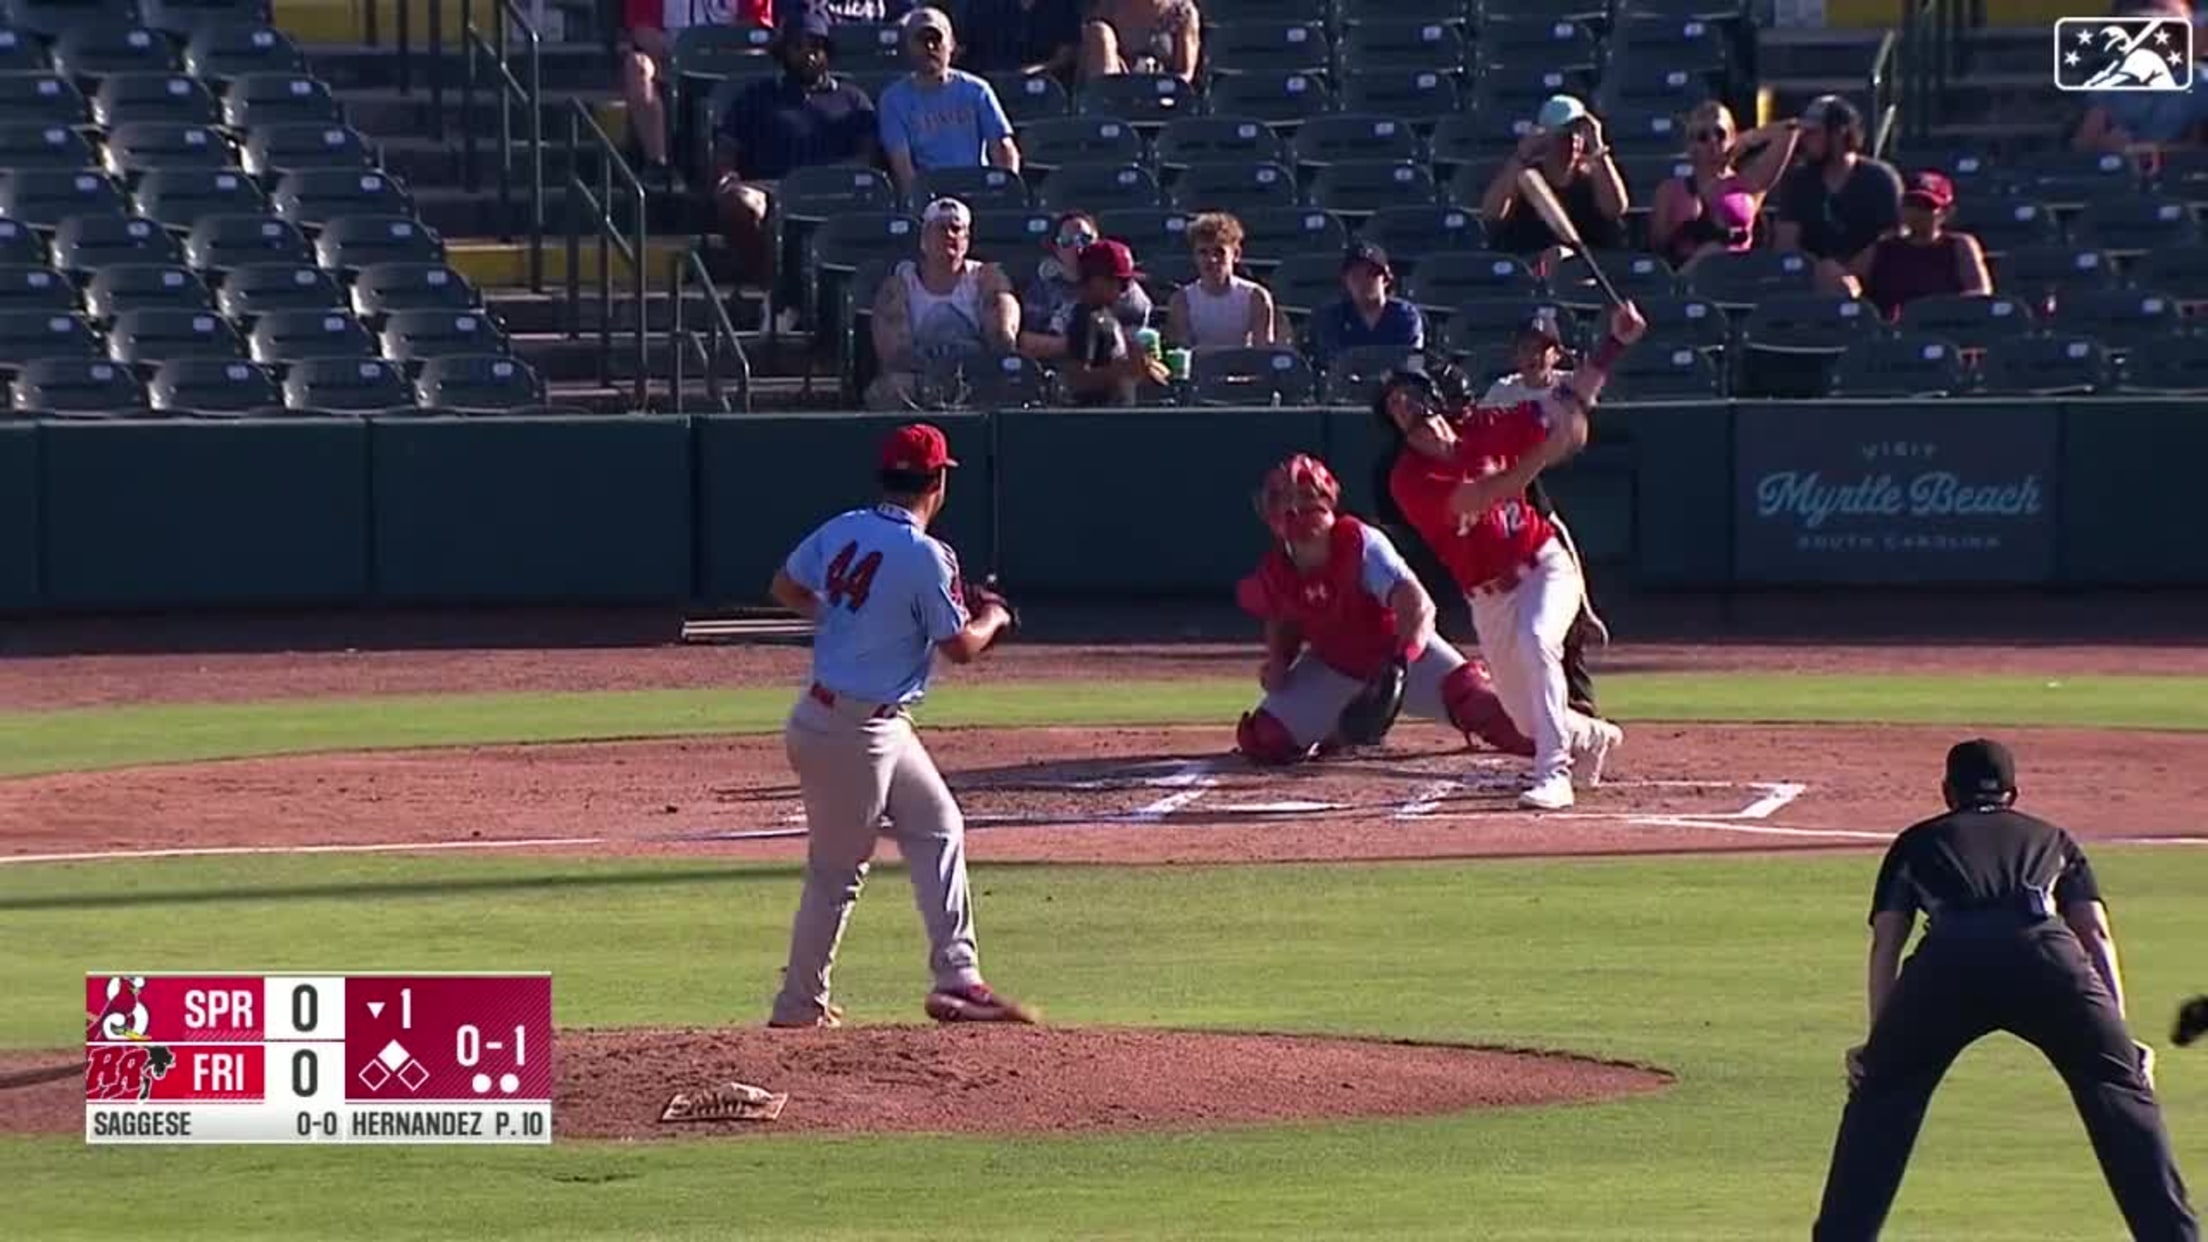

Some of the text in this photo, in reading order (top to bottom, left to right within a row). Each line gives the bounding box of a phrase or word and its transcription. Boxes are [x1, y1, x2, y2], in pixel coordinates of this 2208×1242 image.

[1861, 440, 1937, 458] VISIT
[1757, 470, 2041, 529] Myrtle Beach
[1796, 536, 2001, 549] SOUTH CAROLINA
[825, 540, 884, 614] 44
